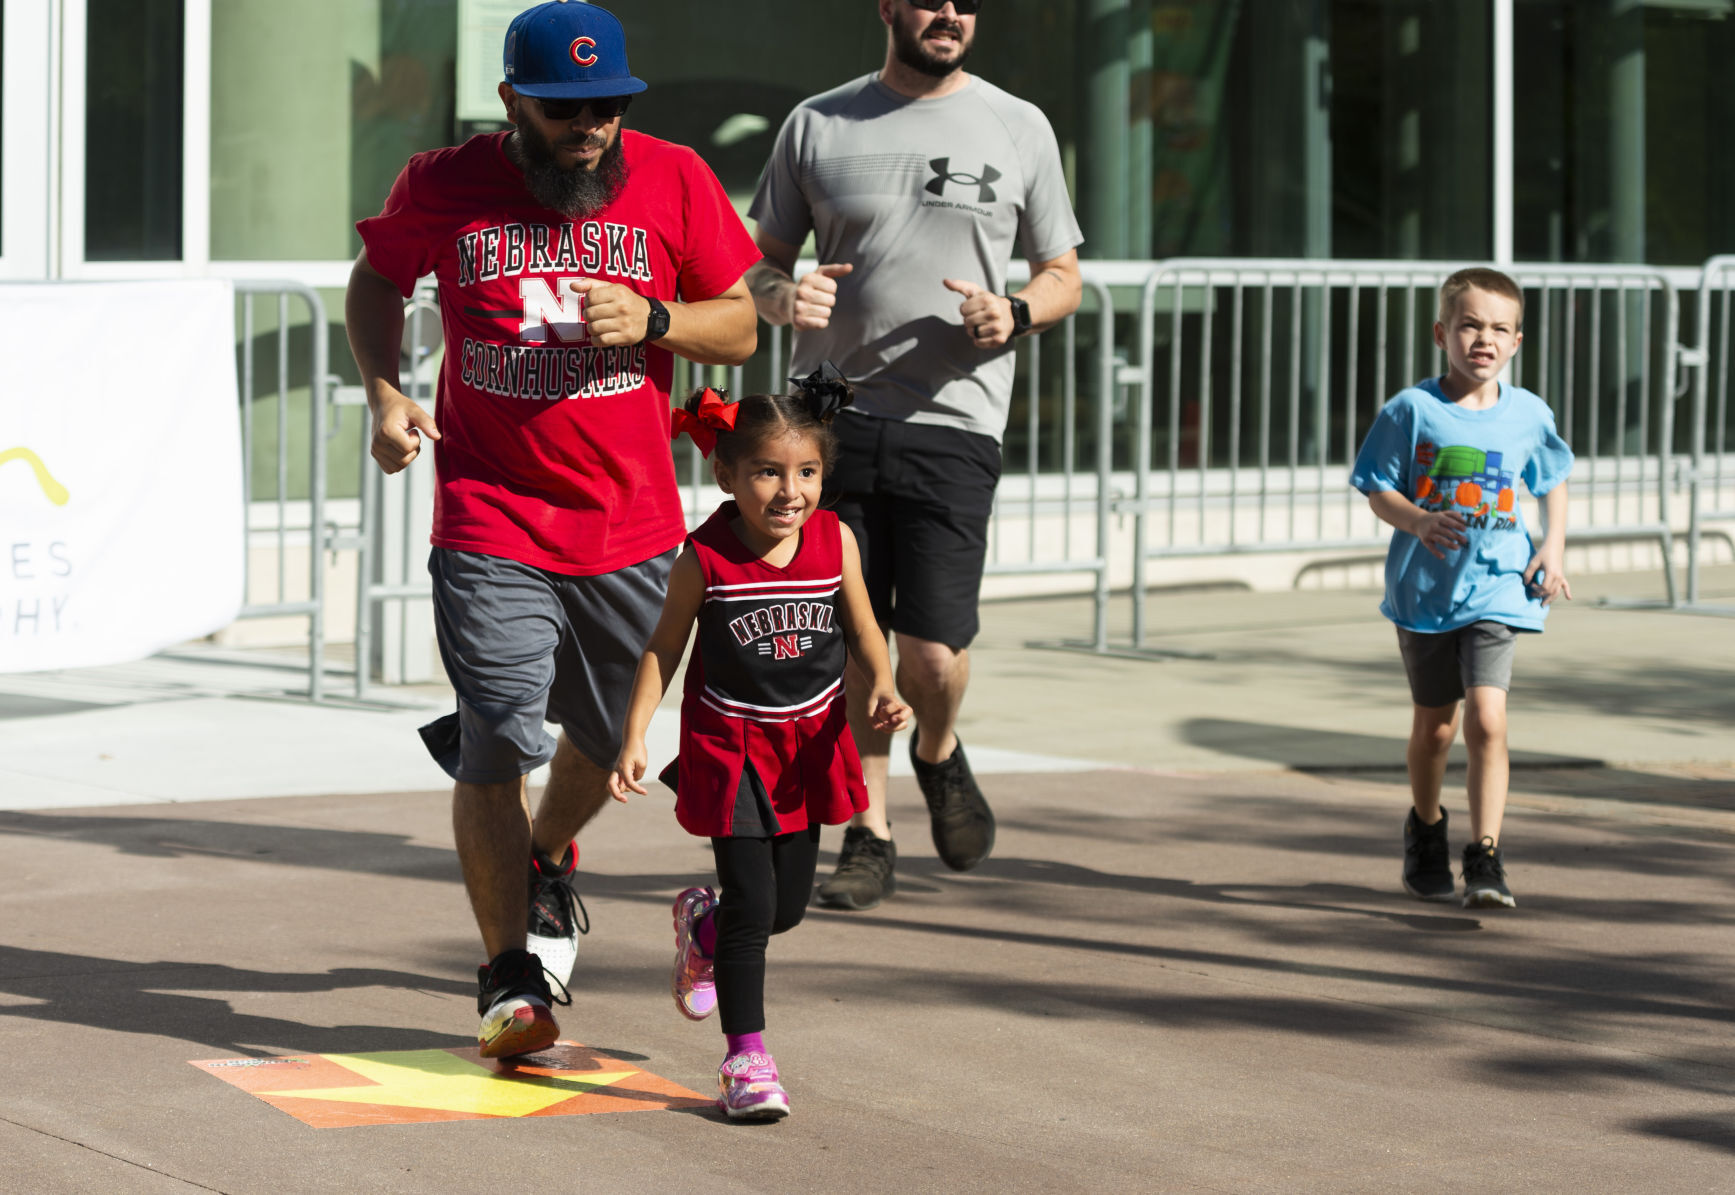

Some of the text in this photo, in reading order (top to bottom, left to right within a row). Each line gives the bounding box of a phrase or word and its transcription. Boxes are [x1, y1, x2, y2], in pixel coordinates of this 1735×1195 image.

[568, 36, 598, 67] C
[922, 200, 953, 208] UNDER
[457, 221, 651, 287] NEBRASKA
[519, 277, 588, 342] N
[461, 337, 646, 400] CORNHUSKERS
[0, 594, 70, 634] HY
[729, 602, 833, 646] NEBRASKA
[773, 634, 800, 660] N
